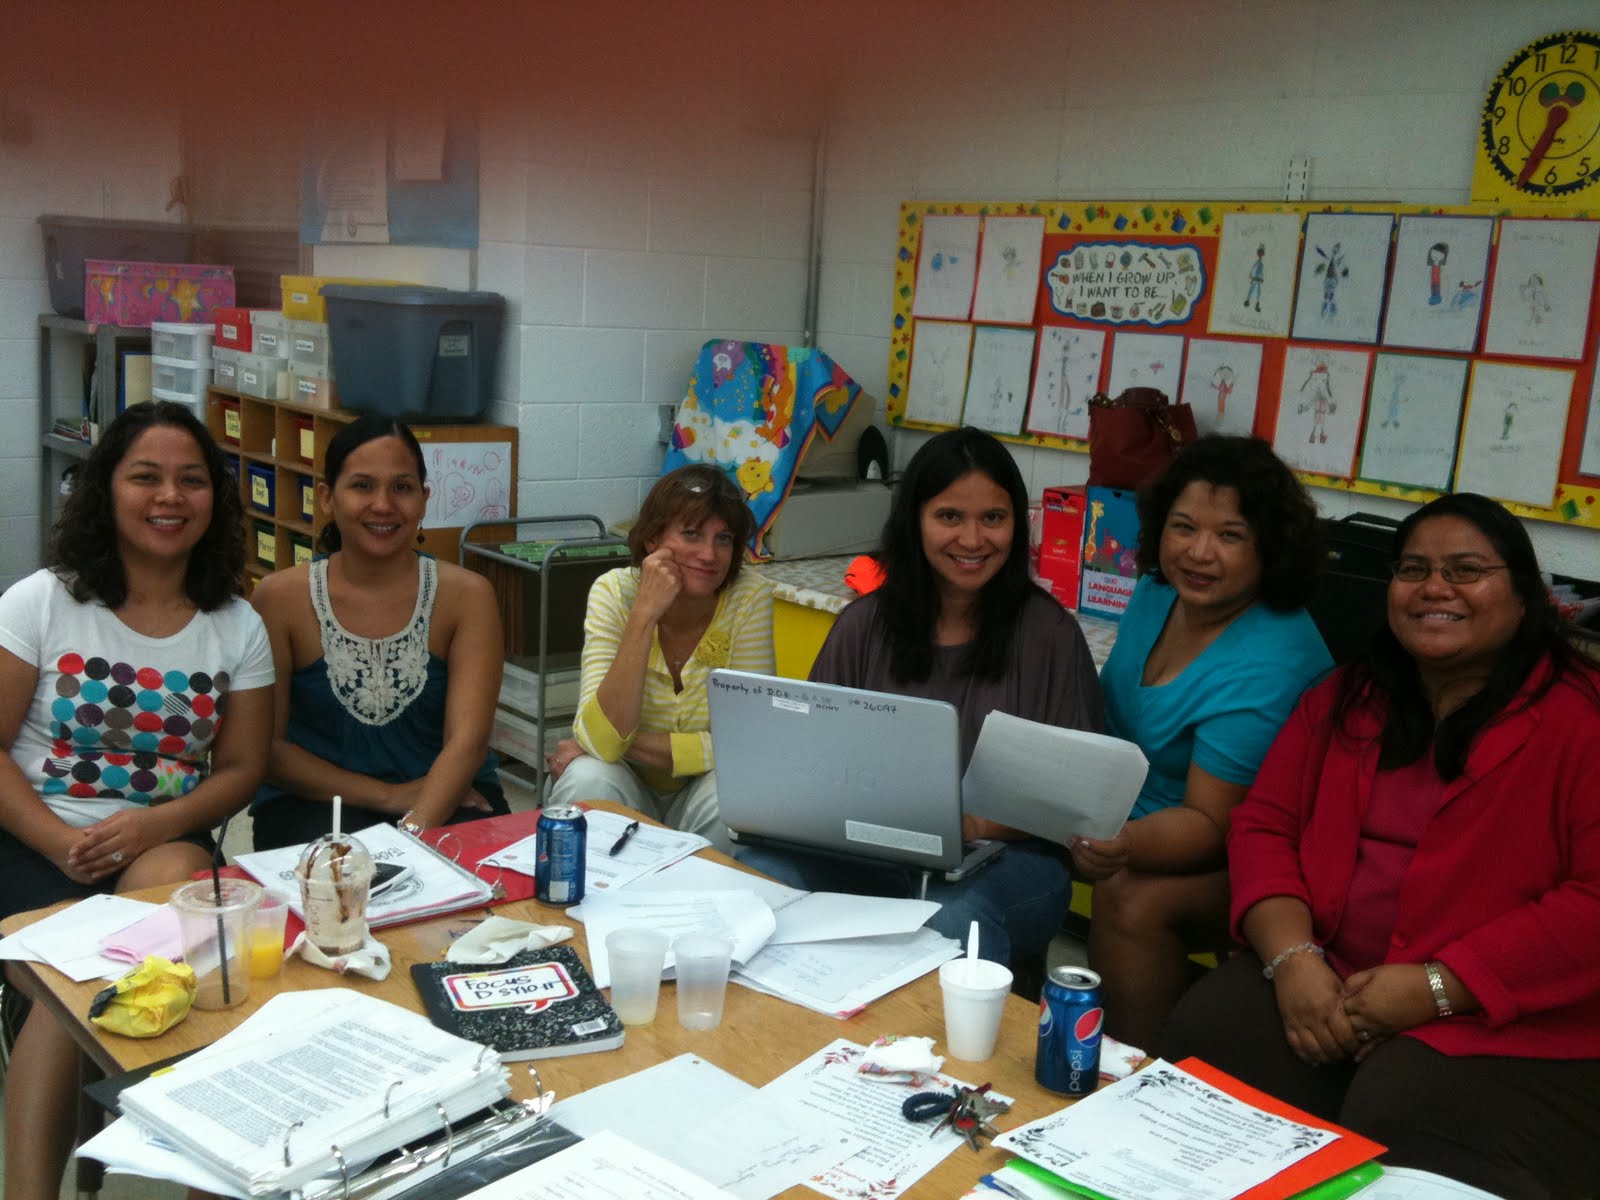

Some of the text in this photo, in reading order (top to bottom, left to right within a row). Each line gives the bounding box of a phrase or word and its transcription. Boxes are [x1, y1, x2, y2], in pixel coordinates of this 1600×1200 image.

[1535, 53, 1547, 73] 11
[1560, 44, 1578, 64] 12
[1507, 76, 1527, 97] 10
[1494, 106, 1507, 126] 9
[1498, 135, 1511, 156] 8
[1544, 166, 1558, 185] 6
[1576, 157, 1592, 177] 5
[1072, 271, 1104, 285] WHEN
[1108, 272, 1113, 284] I
[1116, 272, 1151, 285] GROW
[1079, 285, 1084, 297] I
[1087, 286, 1119, 299] WANT
[1124, 286, 1140, 299] TO
[711, 678, 749, 695] Property
[752, 685, 763, 695] of
[464, 975, 532, 991] FOCUS
[1069, 1050, 1084, 1092] pepsi
